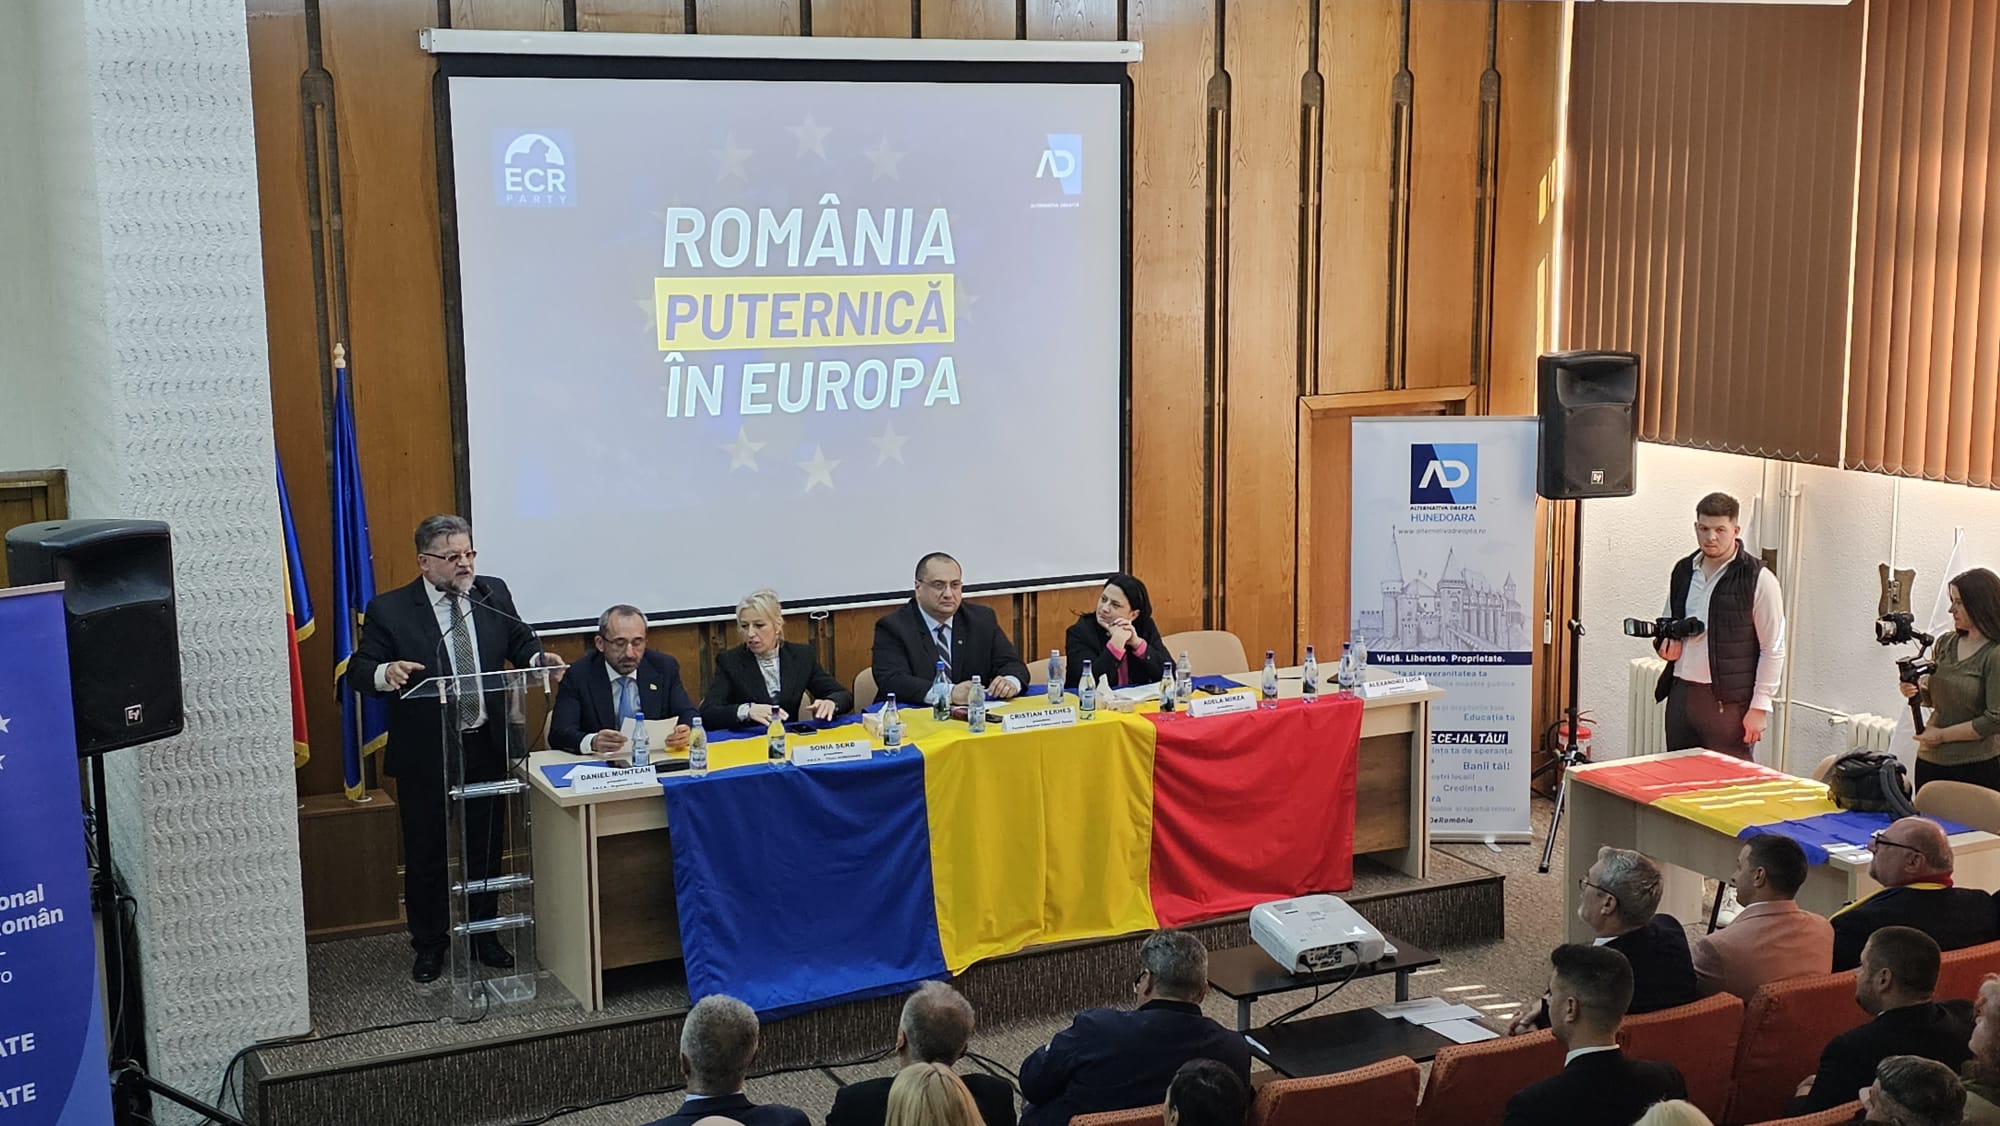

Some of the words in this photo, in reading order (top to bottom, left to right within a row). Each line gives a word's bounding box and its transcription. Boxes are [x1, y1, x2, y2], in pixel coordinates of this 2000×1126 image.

[504, 167, 566, 192] ECR
[506, 194, 567, 204] PARTY
[663, 193, 956, 268] ROMÂNIA
[665, 280, 948, 341] PUTERNICĂ
[664, 352, 725, 417] ÎN
[740, 357, 960, 415] EUROPA
[1411, 513, 1476, 522] HUNEDOARA
[1405, 654, 1449, 663] Libertate.
[1451, 654, 1506, 664] Proprietate.
[1010, 711, 1043, 720] CRISTIAN
[1461, 733, 1477, 744] AL
[810, 743, 834, 752] SONIA
[1462, 747, 1473, 755] de
[1463, 761, 1489, 770] Banii
[580, 771, 609, 780] DANIEL
[611, 767, 651, 777] MUNTEAN
[0, 907, 64, 937] omân
